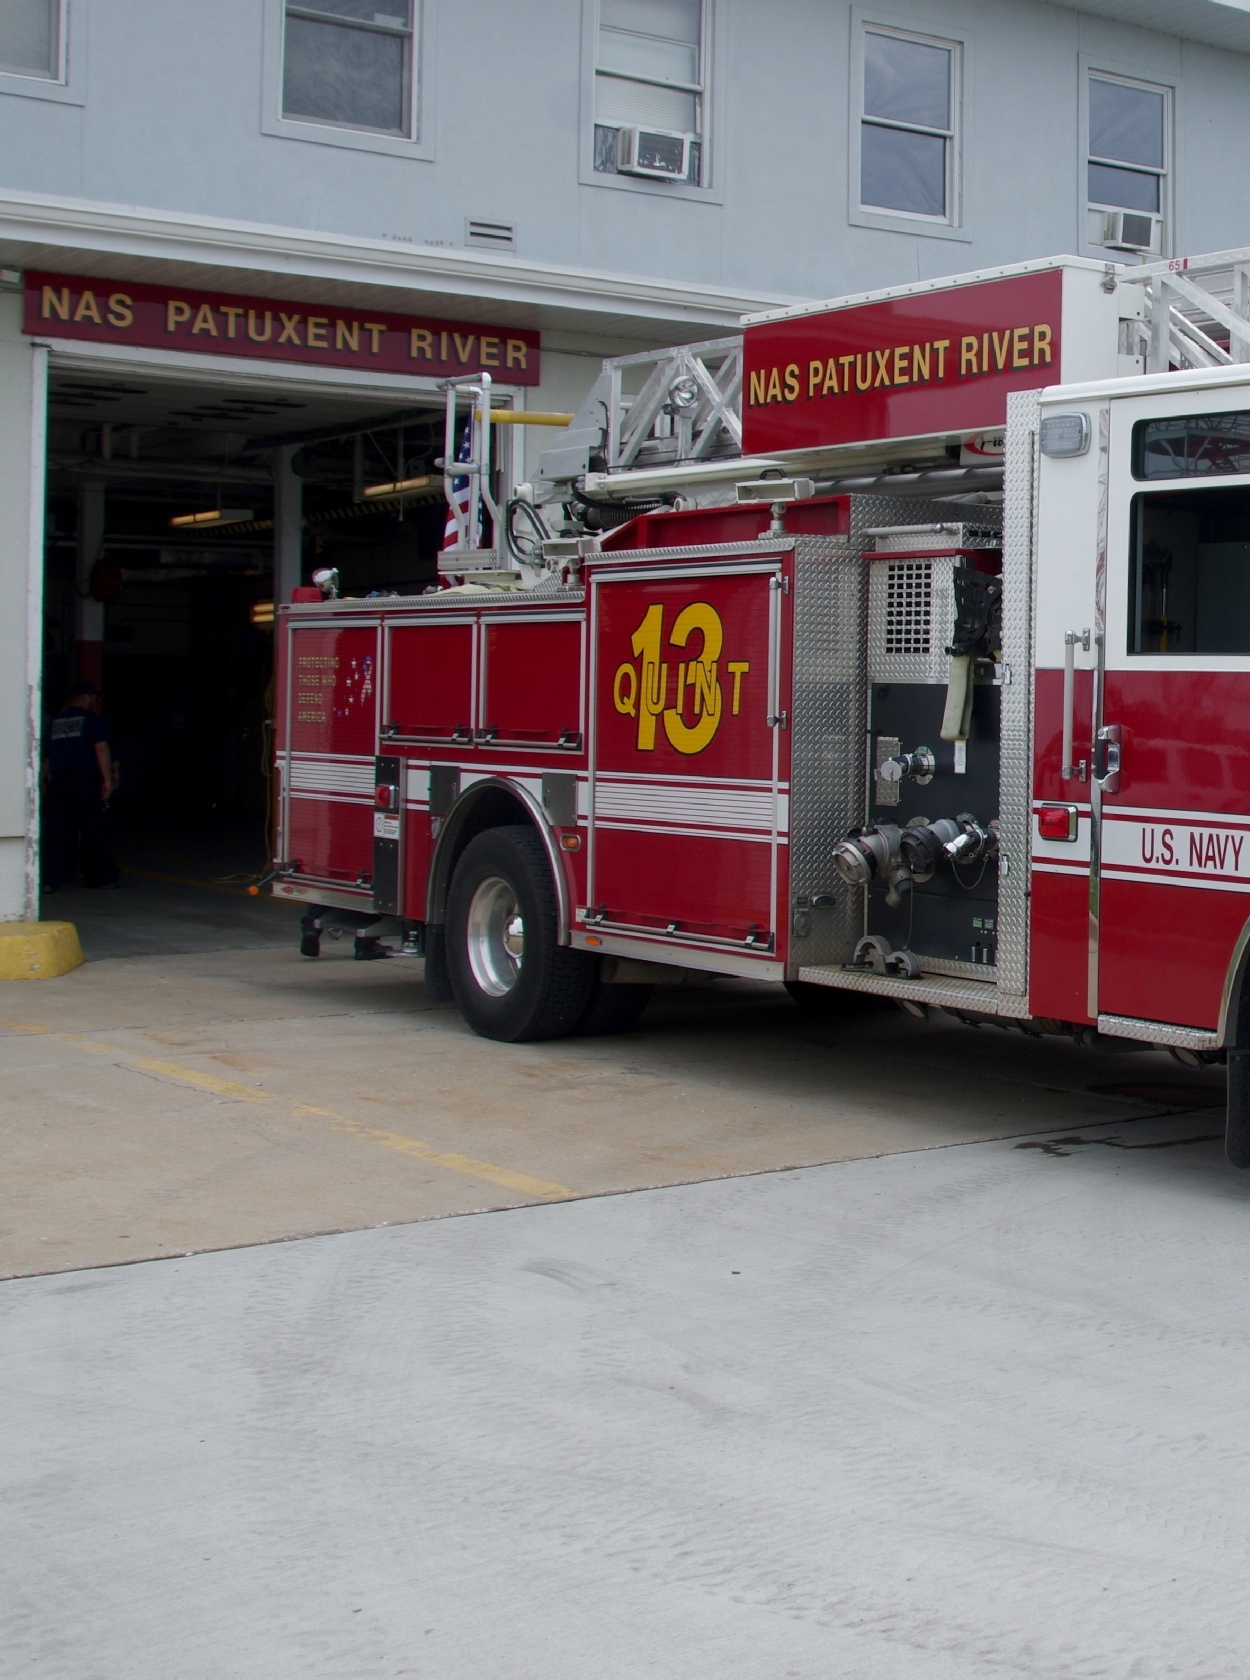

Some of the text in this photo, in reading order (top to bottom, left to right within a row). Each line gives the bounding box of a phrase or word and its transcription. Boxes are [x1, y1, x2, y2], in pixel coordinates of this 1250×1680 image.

[1168, 260, 1181, 271] 65
[41, 285, 528, 370] NAS PATUXENT RIVER
[749, 323, 1053, 406] NAS PATUXENT RIVER
[298, 656, 339, 669] PROTECTING
[613, 660, 750, 718] QUINT
[630, 600, 725, 756] 13
[1141, 827, 1245, 872] U.S. NAVY
